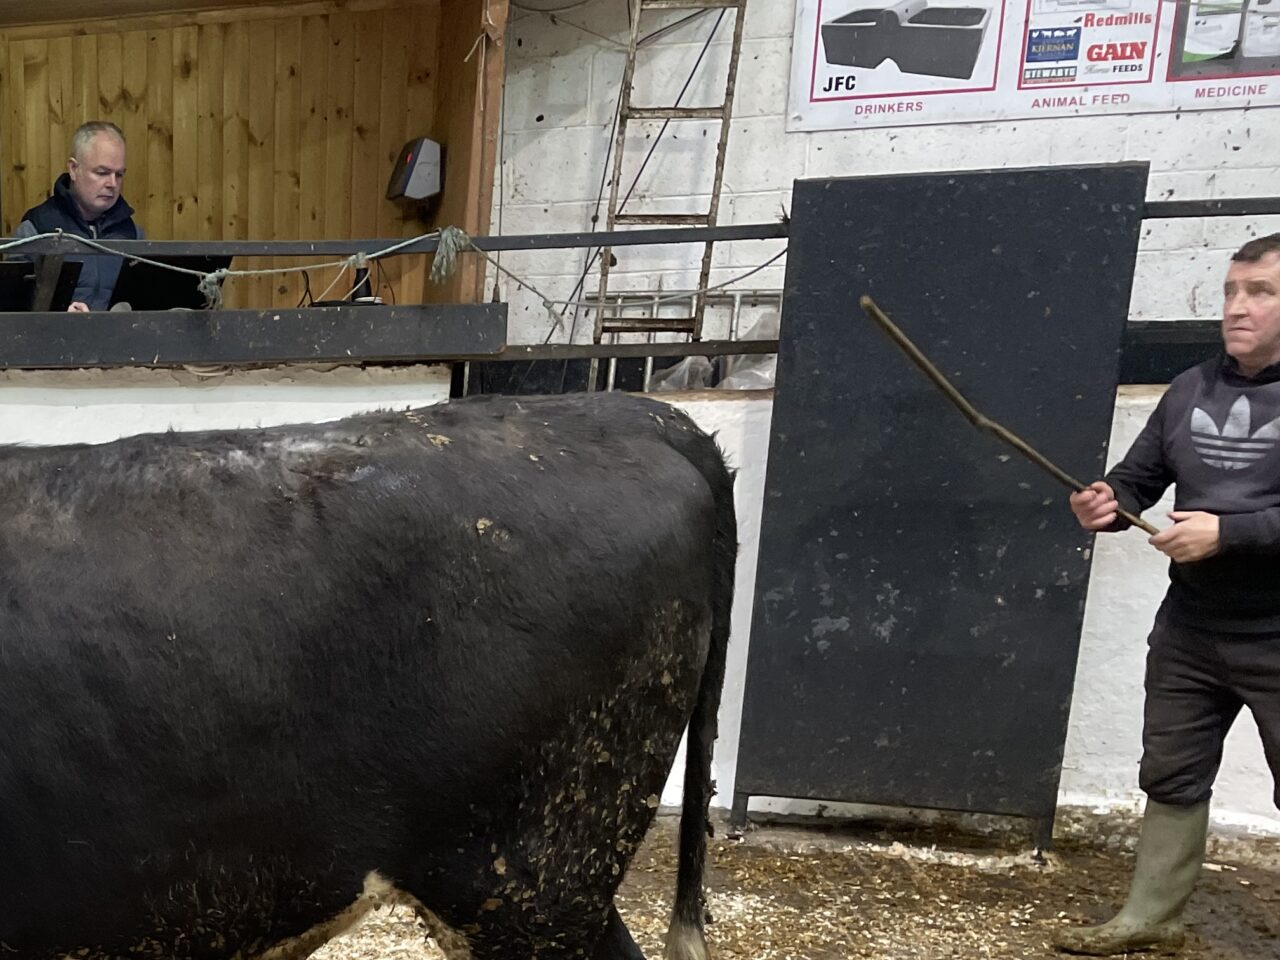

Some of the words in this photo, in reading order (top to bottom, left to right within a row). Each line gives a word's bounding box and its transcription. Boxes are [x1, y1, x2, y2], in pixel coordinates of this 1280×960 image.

[1084, 12, 1152, 28] Redmills
[1086, 41, 1148, 62] GAIN
[1112, 63, 1143, 73] FEEDS
[823, 75, 856, 92] JFC
[1194, 84, 1268, 99] MEDICINE
[854, 101, 924, 115] DRINKERS
[1031, 96, 1087, 109] ANIMAL
[1092, 93, 1131, 105] FEED
